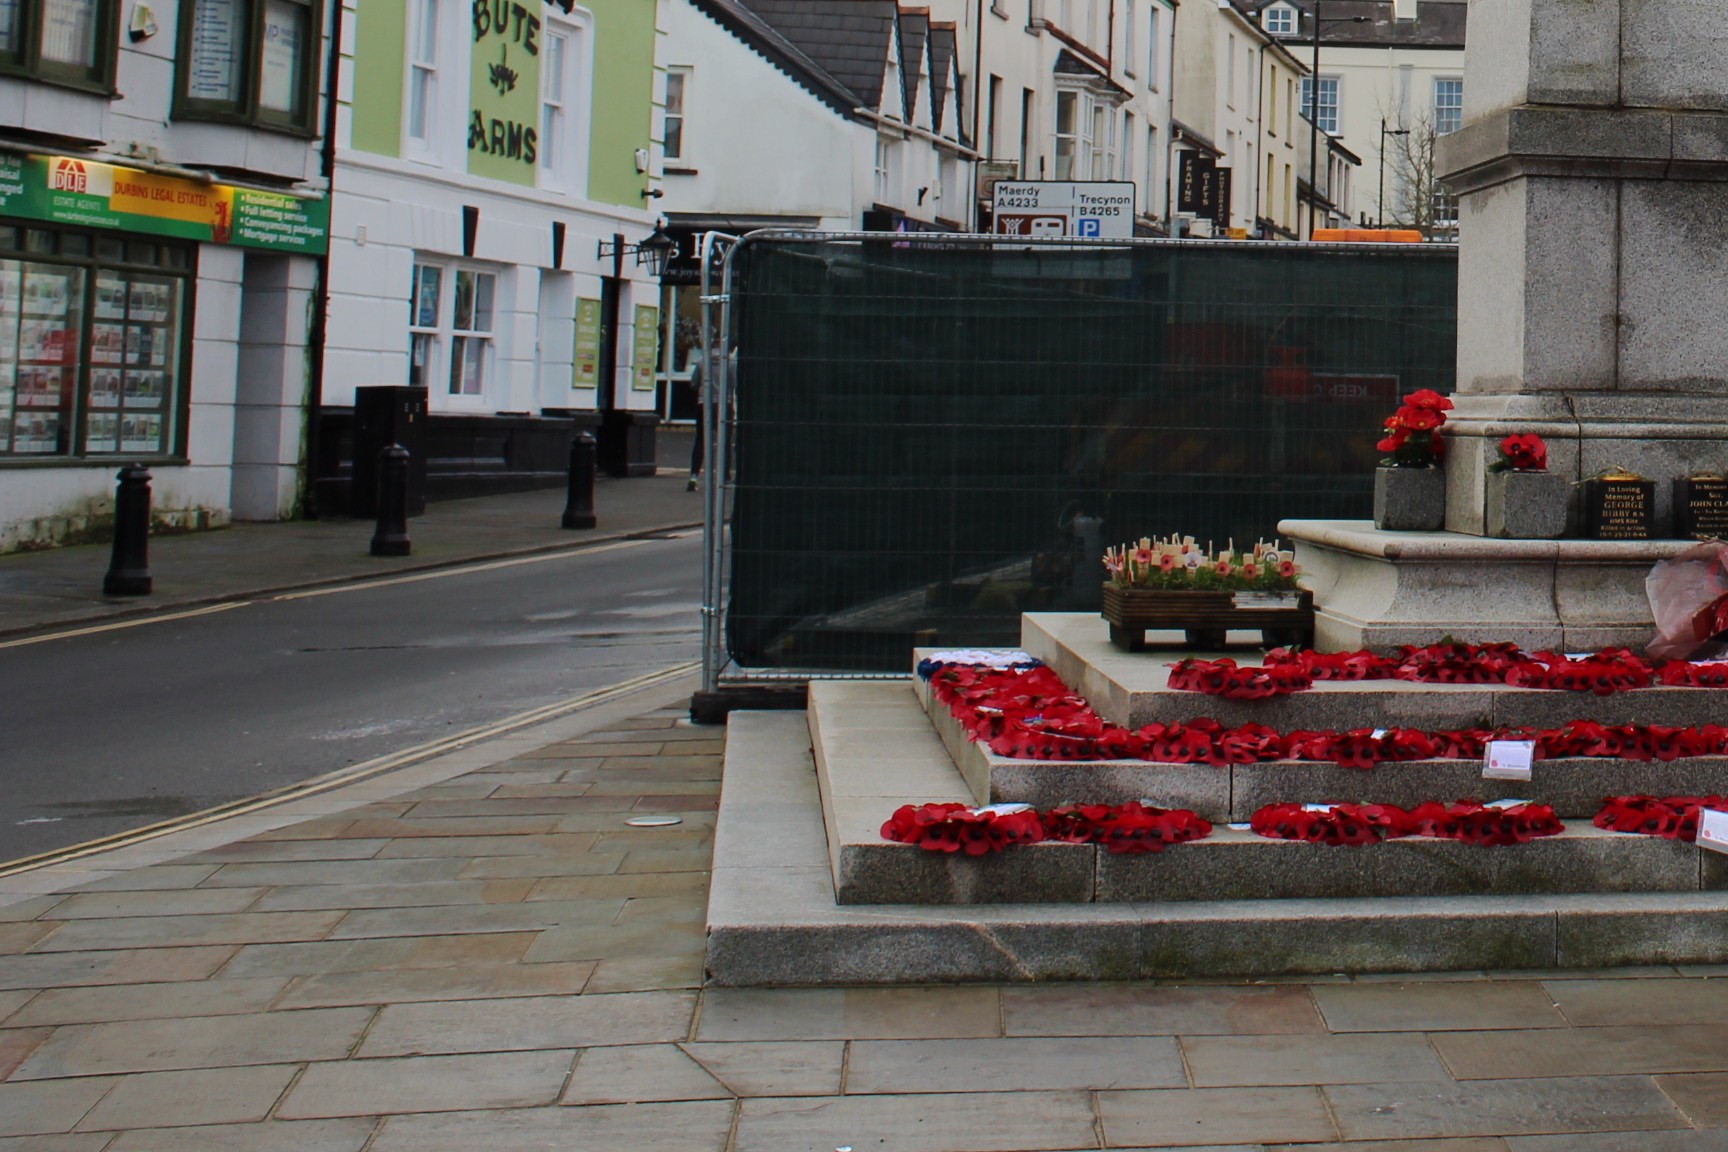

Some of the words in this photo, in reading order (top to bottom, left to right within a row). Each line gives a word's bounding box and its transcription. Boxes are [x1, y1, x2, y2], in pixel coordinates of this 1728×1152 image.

[468, 109, 537, 164] ARMS
[56, 172, 86, 193] DLE
[1202, 172, 1210, 206] GIFTS
[115, 181, 148, 199] DURBINS
[151, 188, 175, 203] LEGAL
[178, 191, 207, 207] ESTATES
[999, 186, 1040, 196] Maerdy
[997, 198, 1039, 208] A4233
[1080, 194, 1130, 205] Trecynon
[1080, 207, 1120, 216] B4265
[1084, 221, 1097, 237] P
